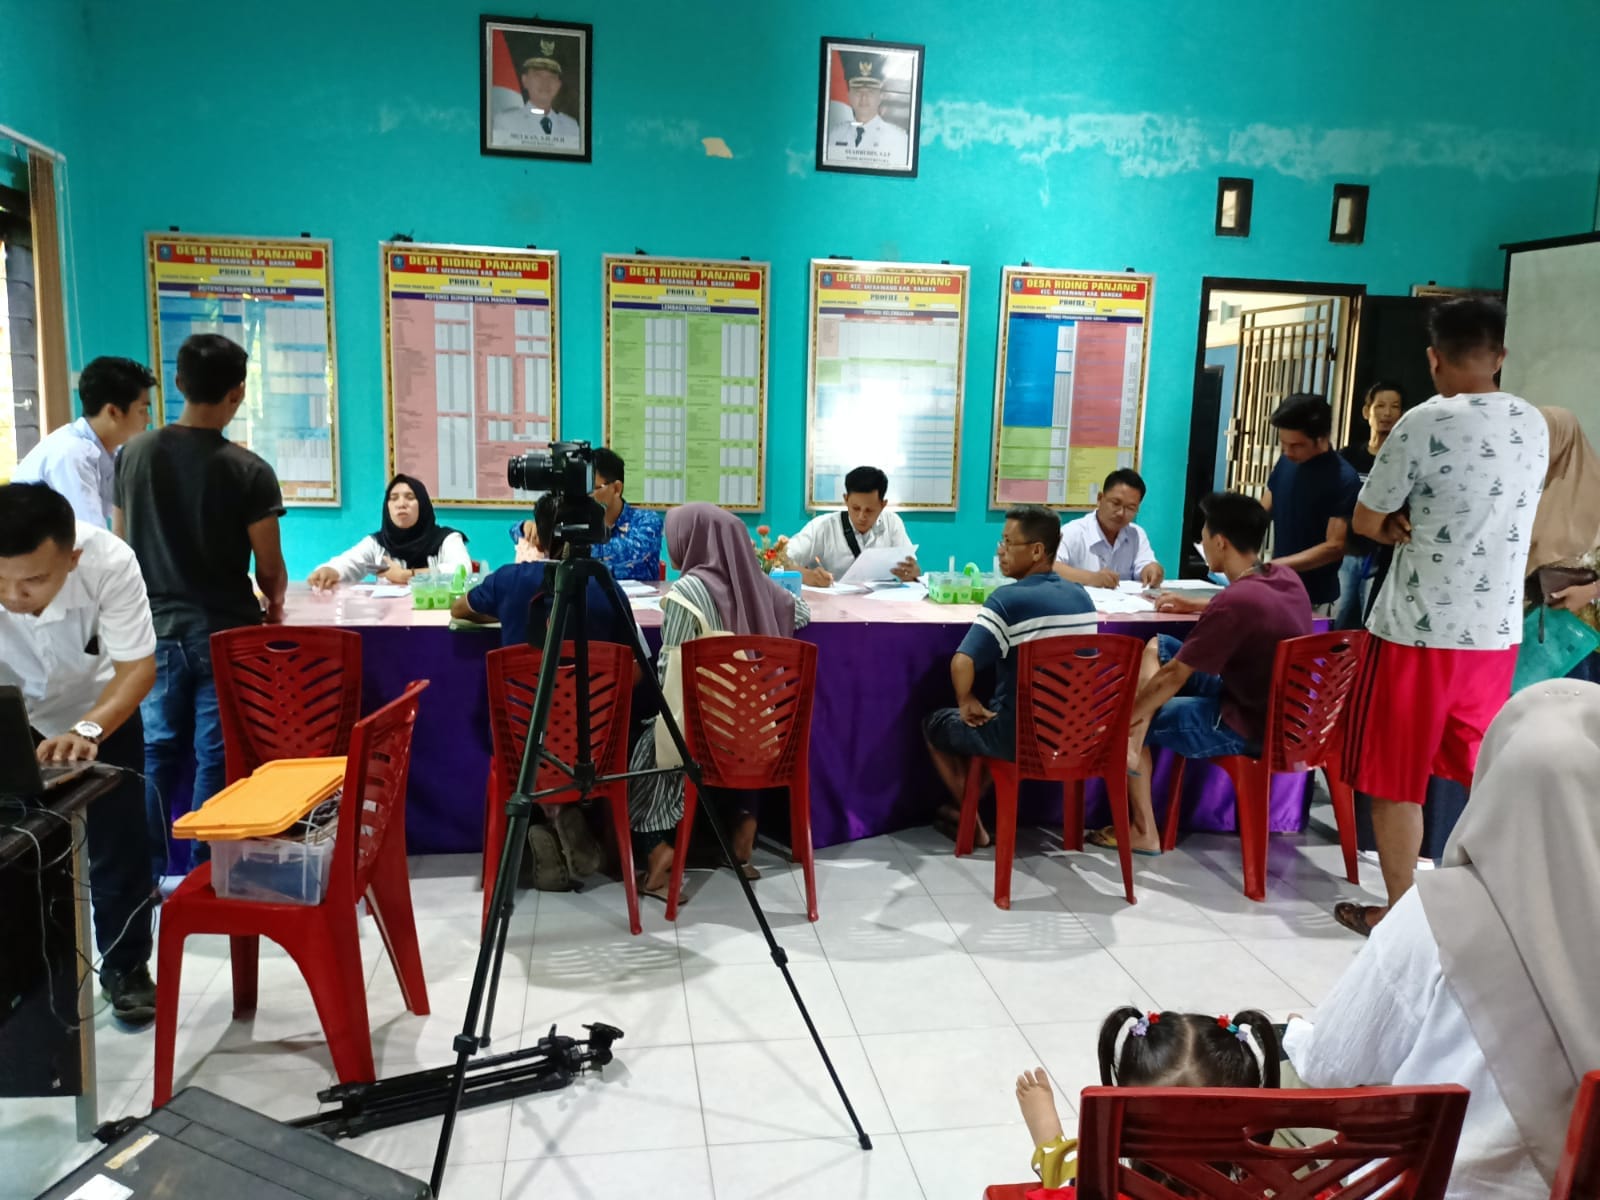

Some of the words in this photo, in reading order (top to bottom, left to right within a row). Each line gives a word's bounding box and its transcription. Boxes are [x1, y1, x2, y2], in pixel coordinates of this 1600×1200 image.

[176, 244, 206, 256] DESA
[211, 245, 252, 259] RIDING
[257, 248, 312, 261] PANJANG
[409, 255, 438, 266] DESA
[441, 257, 481, 268] RIDING
[486, 259, 538, 271] PANJANG
[630, 266, 656, 277] DESA
[660, 268, 696, 279] RIDING
[701, 270, 750, 281] PANJANG
[836, 273, 862, 283] DESA
[866, 274, 900, 284] RIDING
[904, 276, 951, 286] PANJANG
[1027, 279, 1050, 288] DESA
[1055, 280, 1088, 290] RIDING
[1092, 282, 1137, 292] PANJANG
